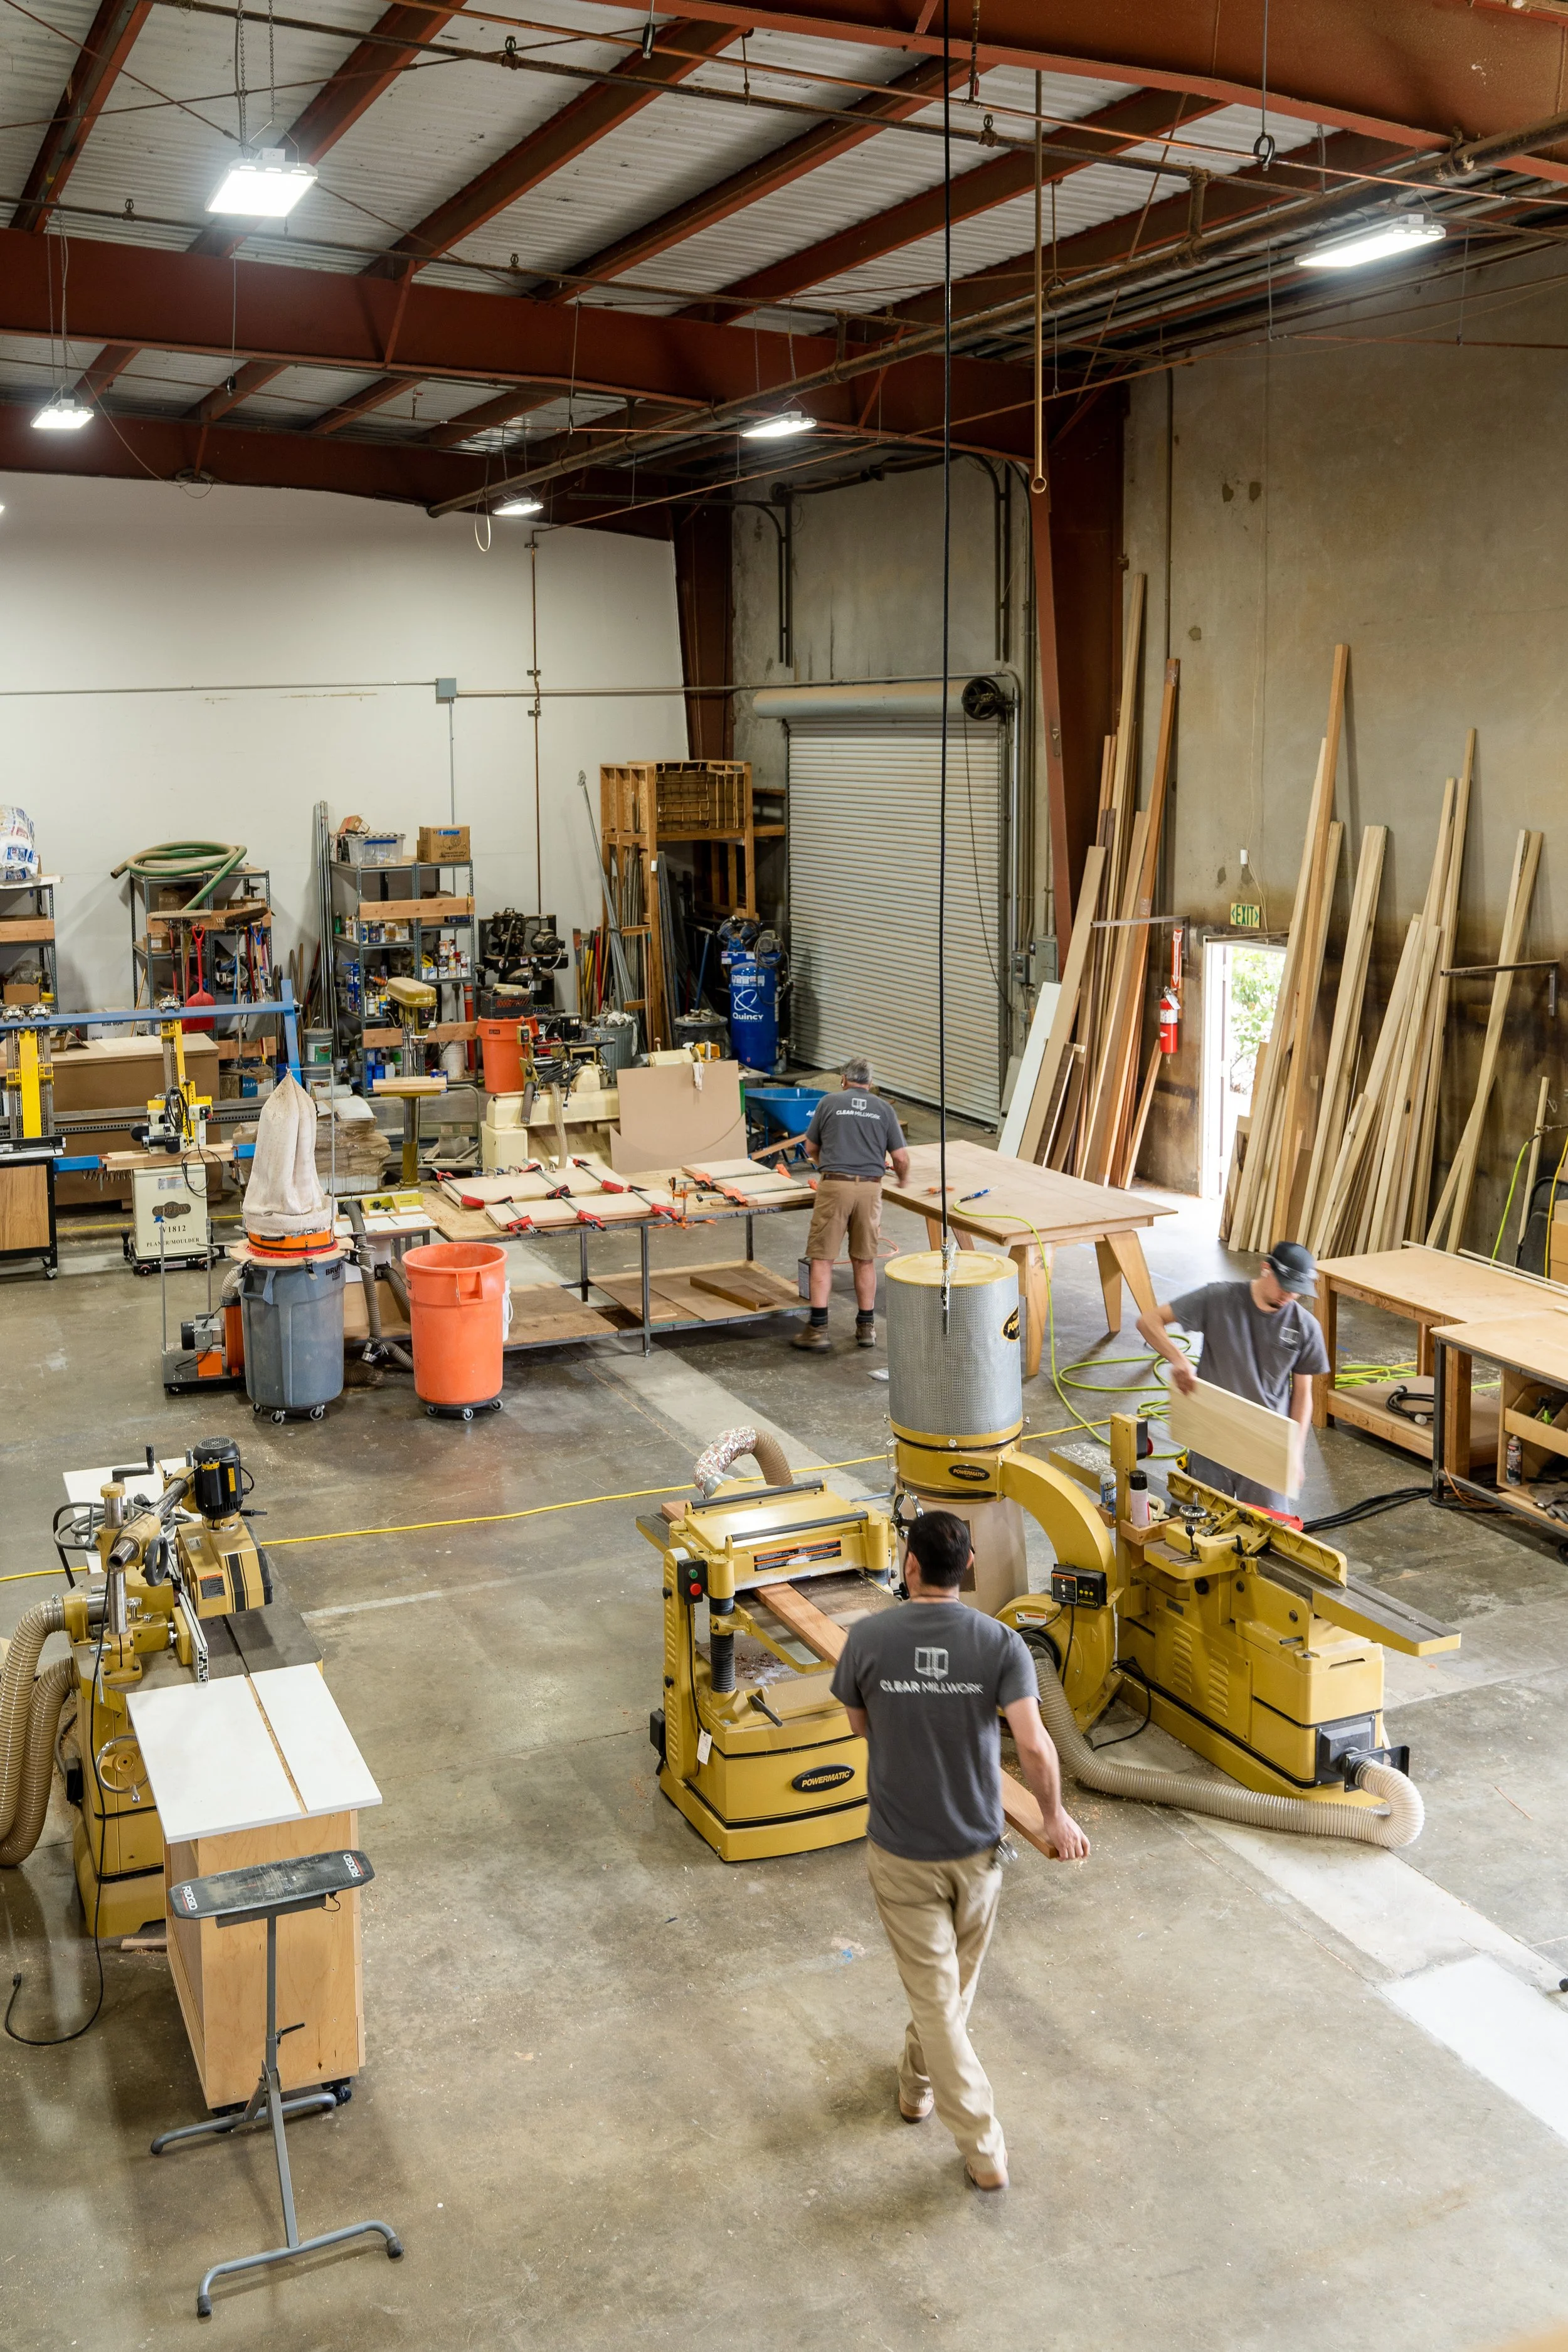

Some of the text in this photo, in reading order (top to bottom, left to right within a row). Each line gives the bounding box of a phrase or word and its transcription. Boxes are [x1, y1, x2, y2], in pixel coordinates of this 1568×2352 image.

[1236, 904, 1254, 926] EXIT
[733, 1012, 764, 1020] Quincy
[174, 1205, 188, 1214] FOX
[953, 1468, 985, 1478] POWERMATIC
[879, 1679, 921, 1693] CLEAR
[802, 1771, 850, 1788] POWERMATIC
[342, 1853, 361, 1878] RIDGID
[182, 1885, 198, 1911] RIDGID
